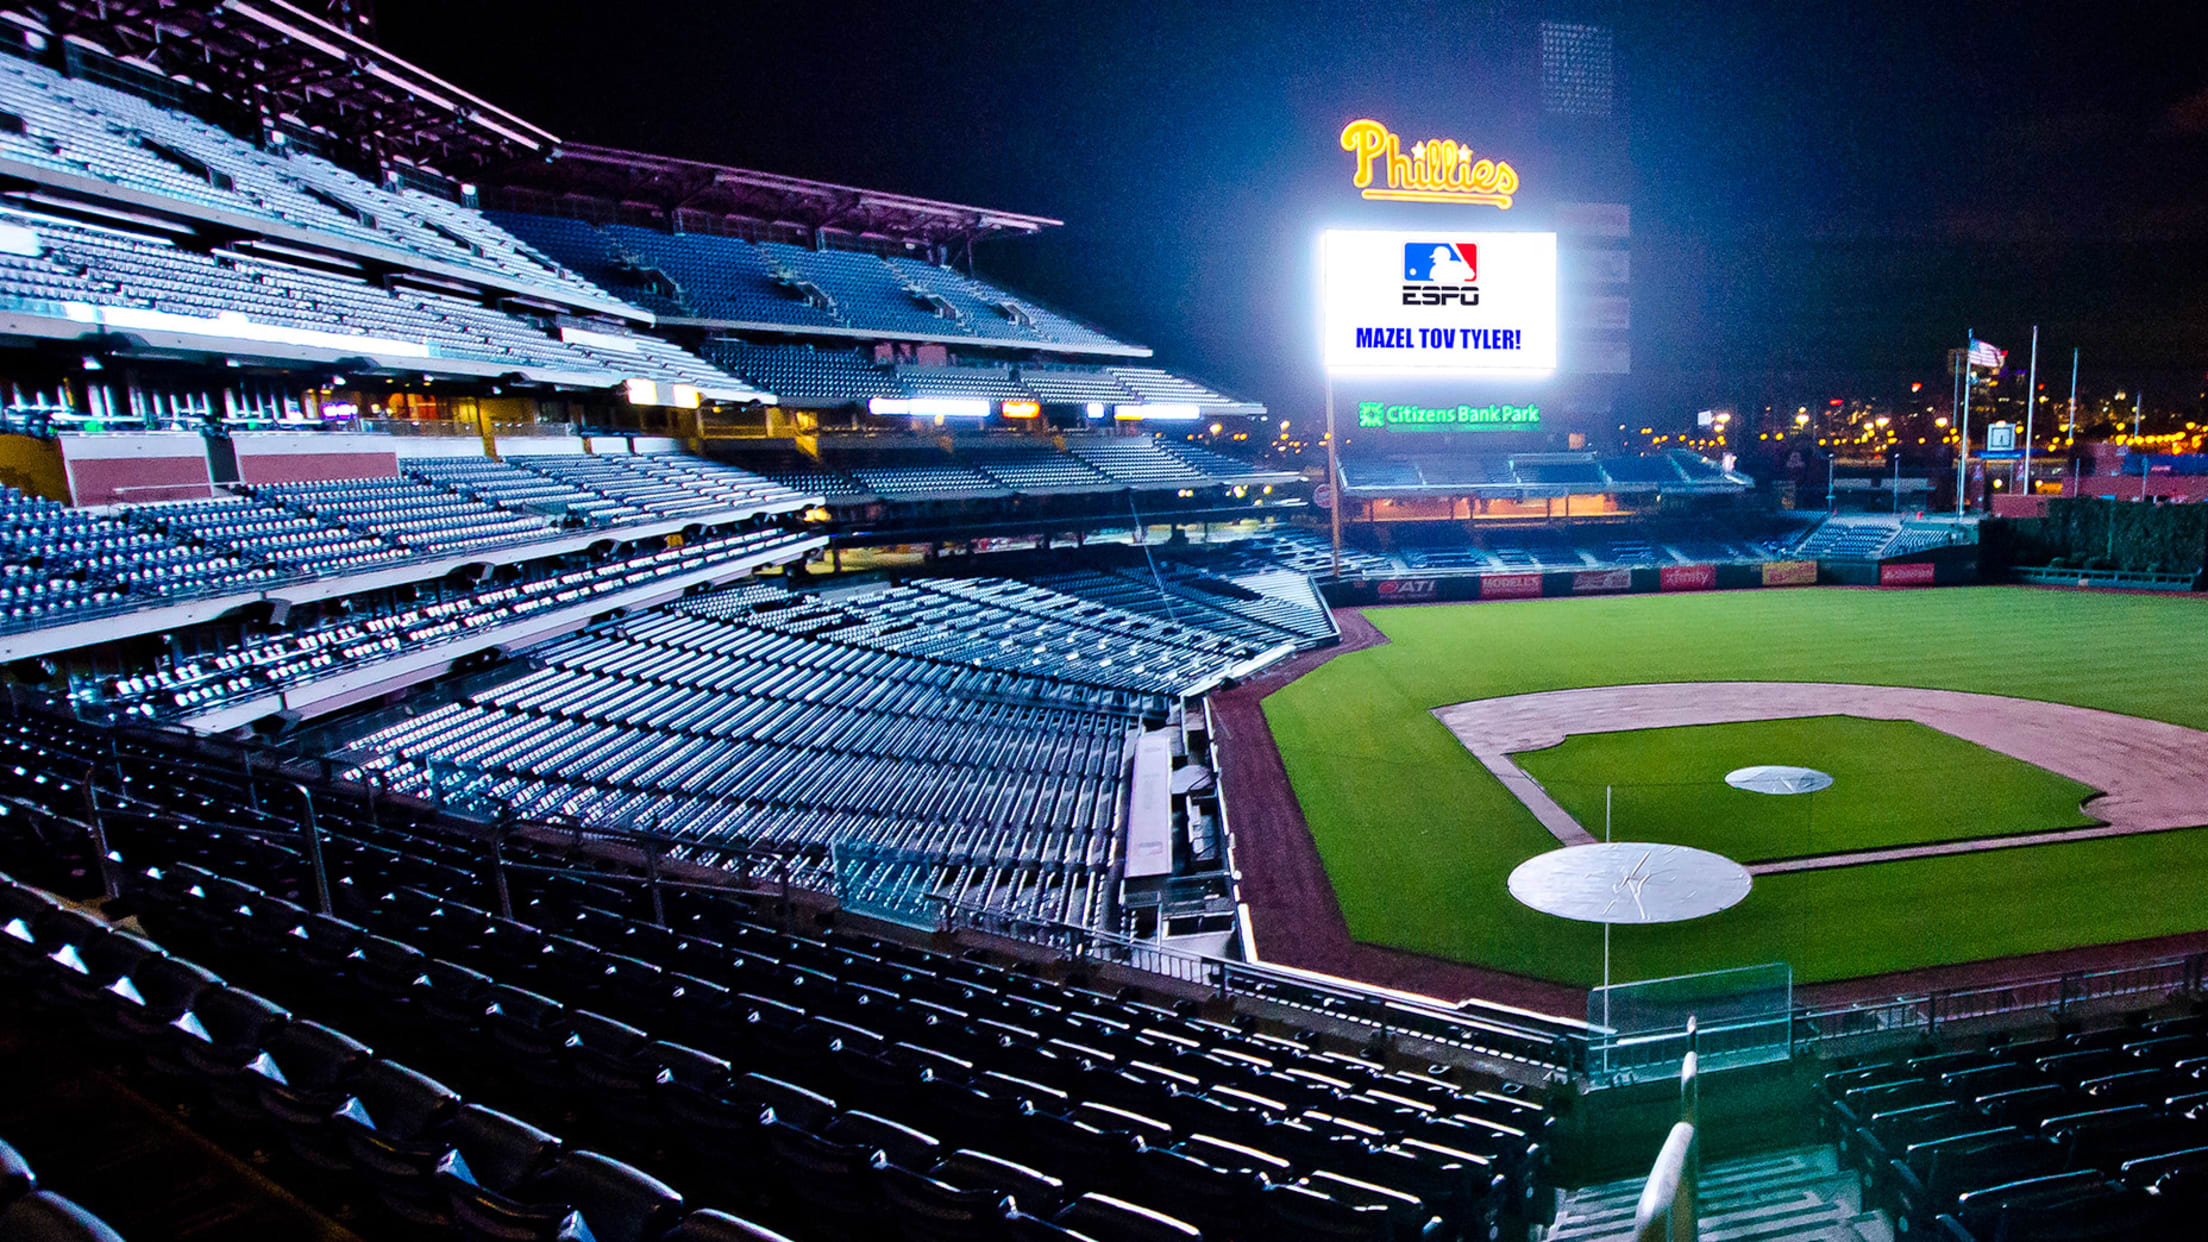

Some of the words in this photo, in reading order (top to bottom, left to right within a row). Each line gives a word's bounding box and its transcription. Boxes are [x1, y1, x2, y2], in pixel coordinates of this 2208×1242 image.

[1340, 118, 1519, 197] Phillies
[1402, 285, 1480, 306] ESPO
[1356, 327, 1415, 349] MAZEL
[1418, 328, 1456, 349] TOV
[1459, 328, 1522, 350] TYLER!
[1385, 404, 1457, 424] Citizens
[1457, 403, 1501, 424] Bank
[1501, 403, 1541, 424] Park
[1397, 580, 1436, 593] ATI
